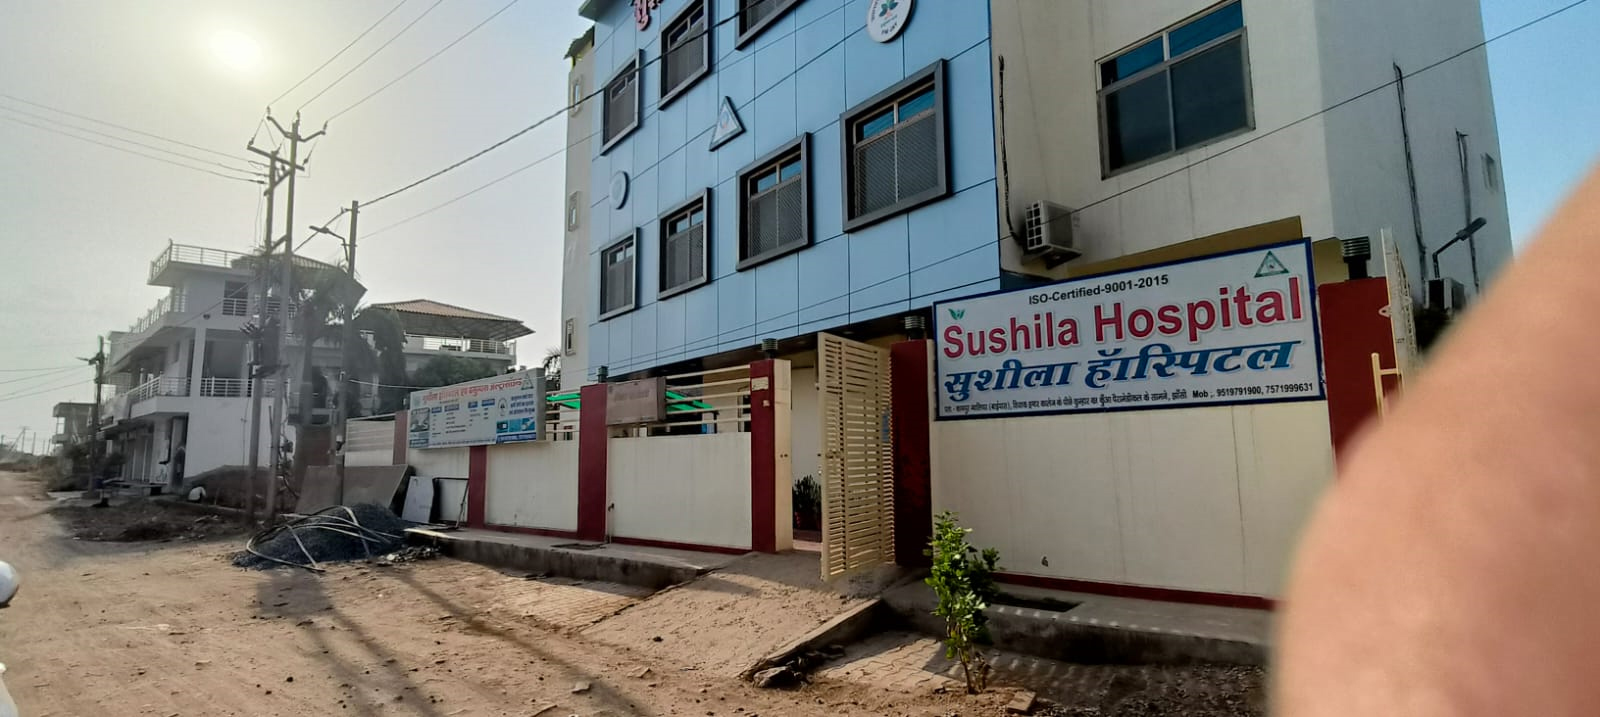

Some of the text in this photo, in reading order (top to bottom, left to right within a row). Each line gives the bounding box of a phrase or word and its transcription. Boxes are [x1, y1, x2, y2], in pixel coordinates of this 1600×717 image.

[1028, 273, 1169, 306] ISO-Certified-9001-2015
[943, 276, 1303, 359] Sushila Hospital
[944, 339, 1302, 402] सुशीला हॉस्पिटल
[1192, 389, 1209, 398] Mob
